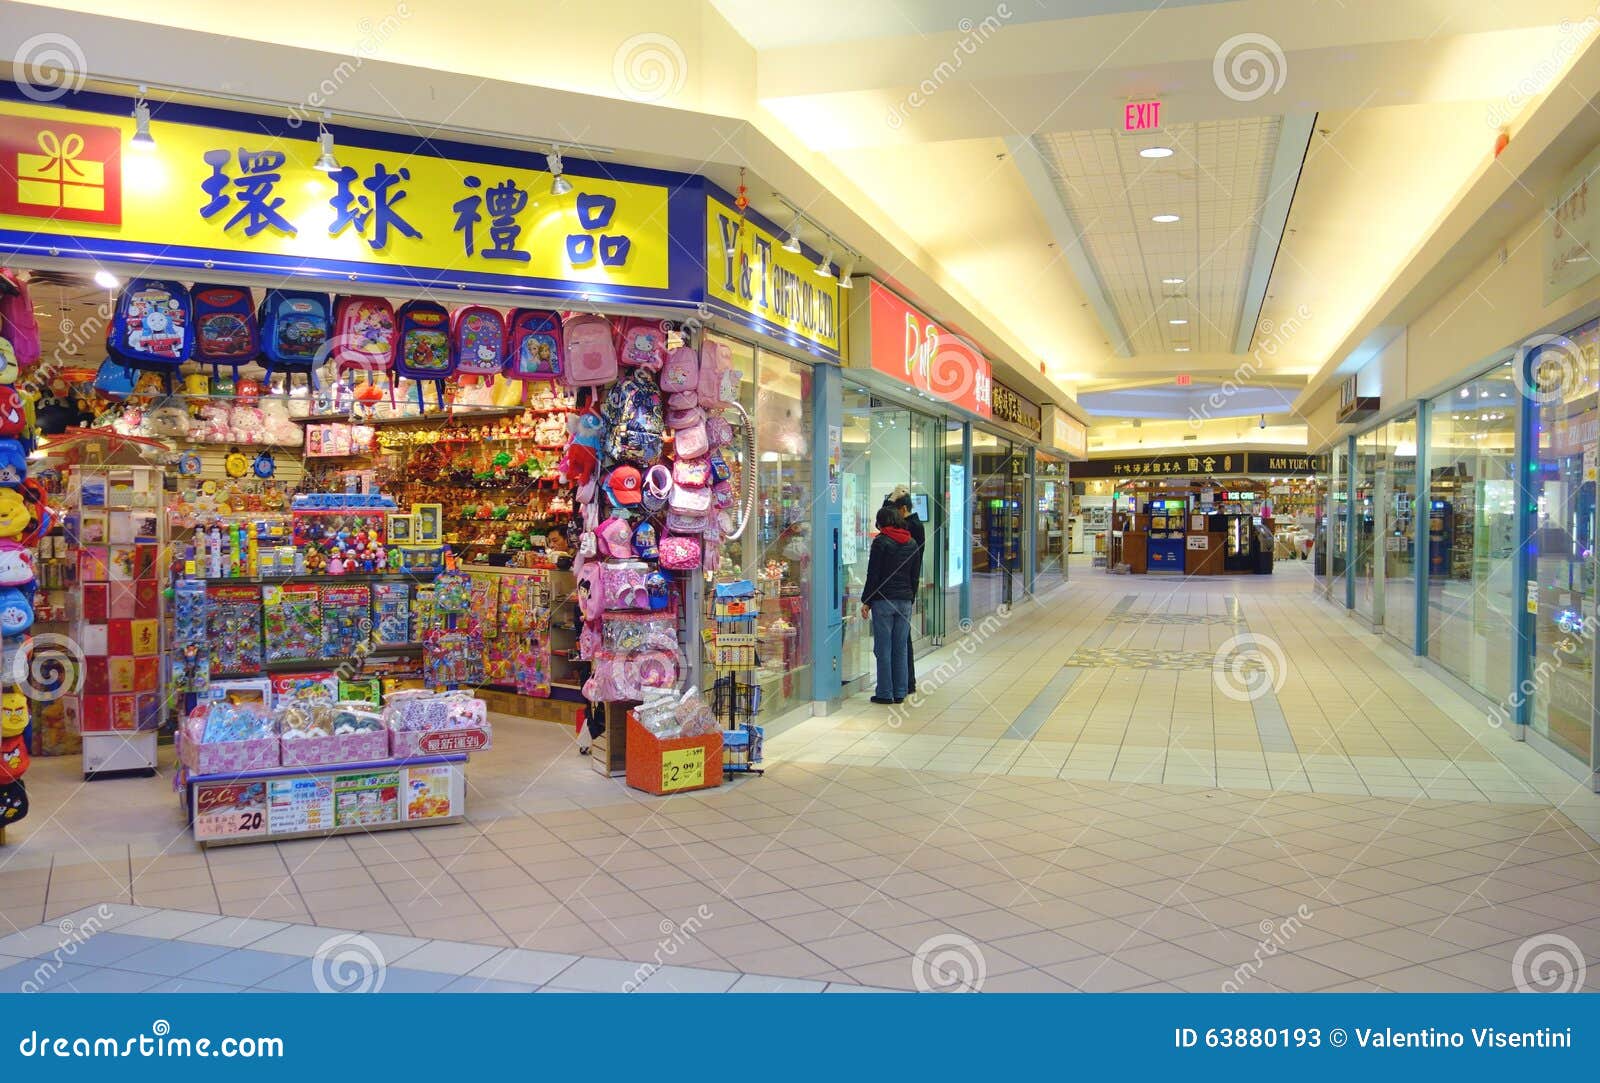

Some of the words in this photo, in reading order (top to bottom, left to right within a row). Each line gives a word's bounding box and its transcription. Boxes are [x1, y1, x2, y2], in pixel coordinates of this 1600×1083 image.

[1125, 102, 1161, 130] EXIT
[200, 147, 634, 268] 環球禮品
[773, 263, 801, 322] GIFTS
[1269, 457, 1287, 470] KAM
[1288, 458, 1309, 471] YUEN
[238, 811, 263, 831] 20
